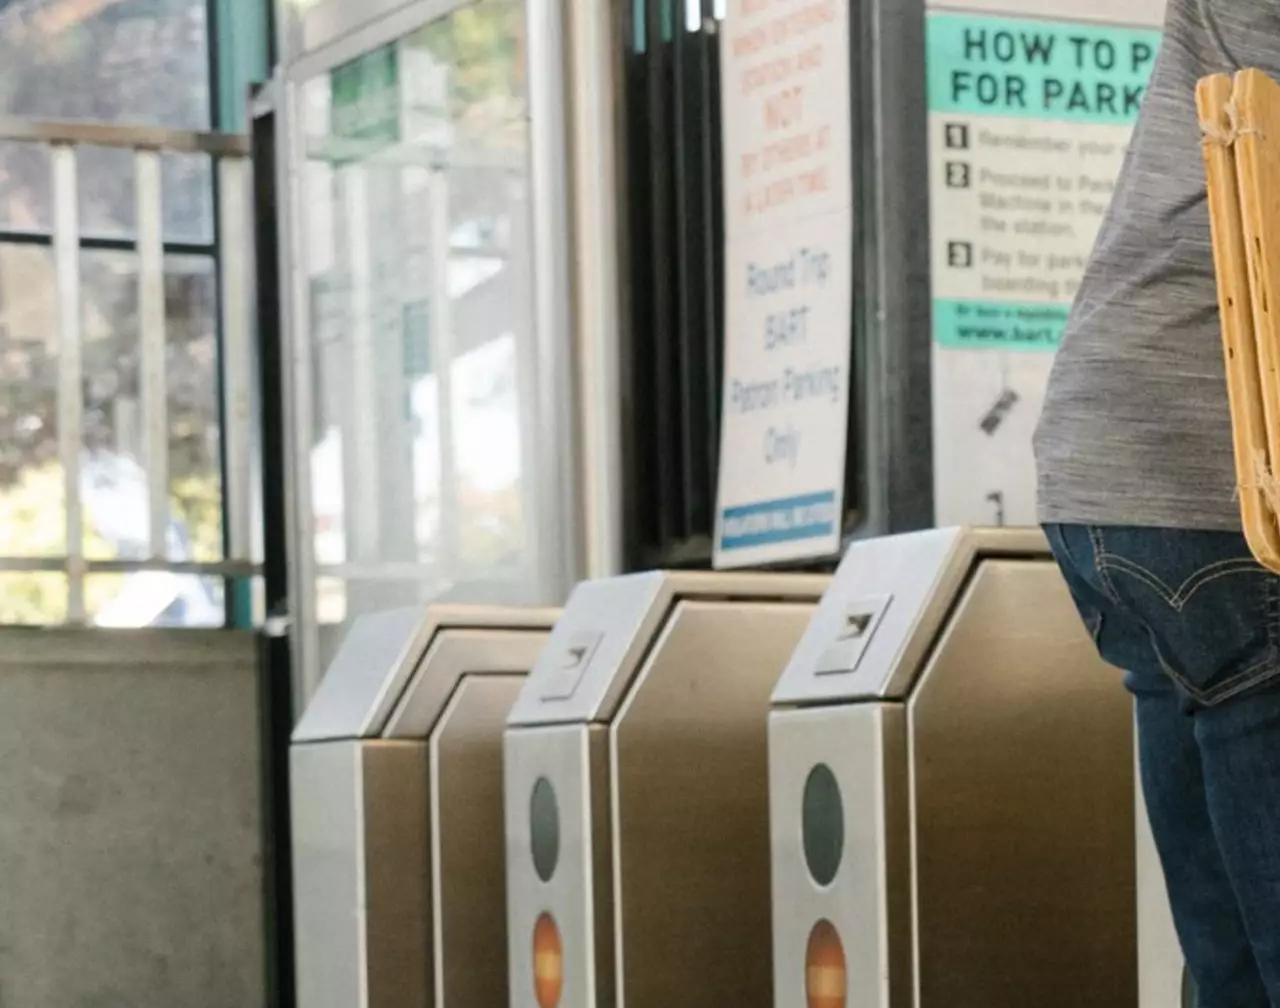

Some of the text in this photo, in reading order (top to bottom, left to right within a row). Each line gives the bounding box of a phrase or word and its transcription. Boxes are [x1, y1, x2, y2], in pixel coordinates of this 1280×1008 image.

[963, 27, 1055, 65] HOW
[1068, 37, 1116, 70] TO
[951, 71, 1027, 107] FOR
[764, 305, 812, 351] BART
